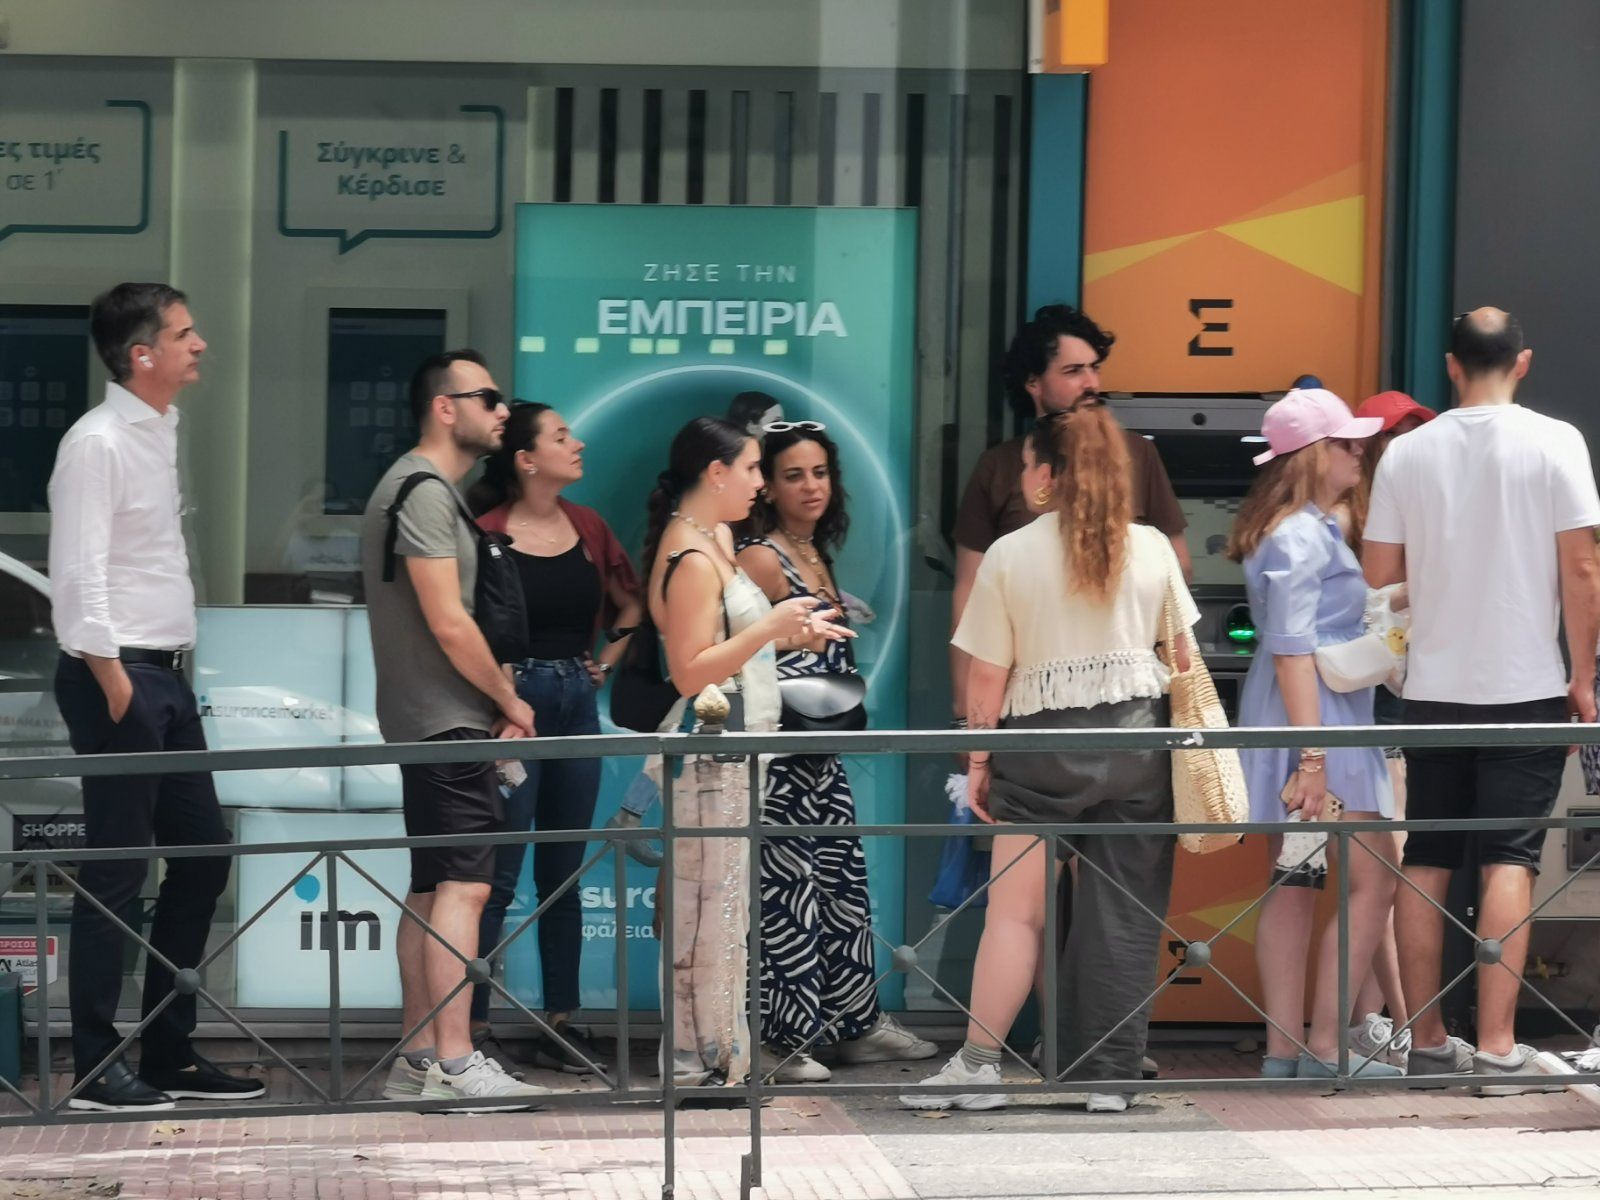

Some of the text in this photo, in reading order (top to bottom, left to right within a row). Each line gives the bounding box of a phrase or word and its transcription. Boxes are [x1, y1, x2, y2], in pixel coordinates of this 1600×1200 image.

[28, 136, 101, 164] τιμές
[317, 141, 466, 169] Σύγκρινε &
[6, 174, 36, 191] σε
[337, 174, 446, 200] Κέρδισε
[643, 263, 796, 283] ΖΗΣΕ ΤΗΝ
[597, 299, 848, 338] ΕΜΠΕΙΡΙΑ
